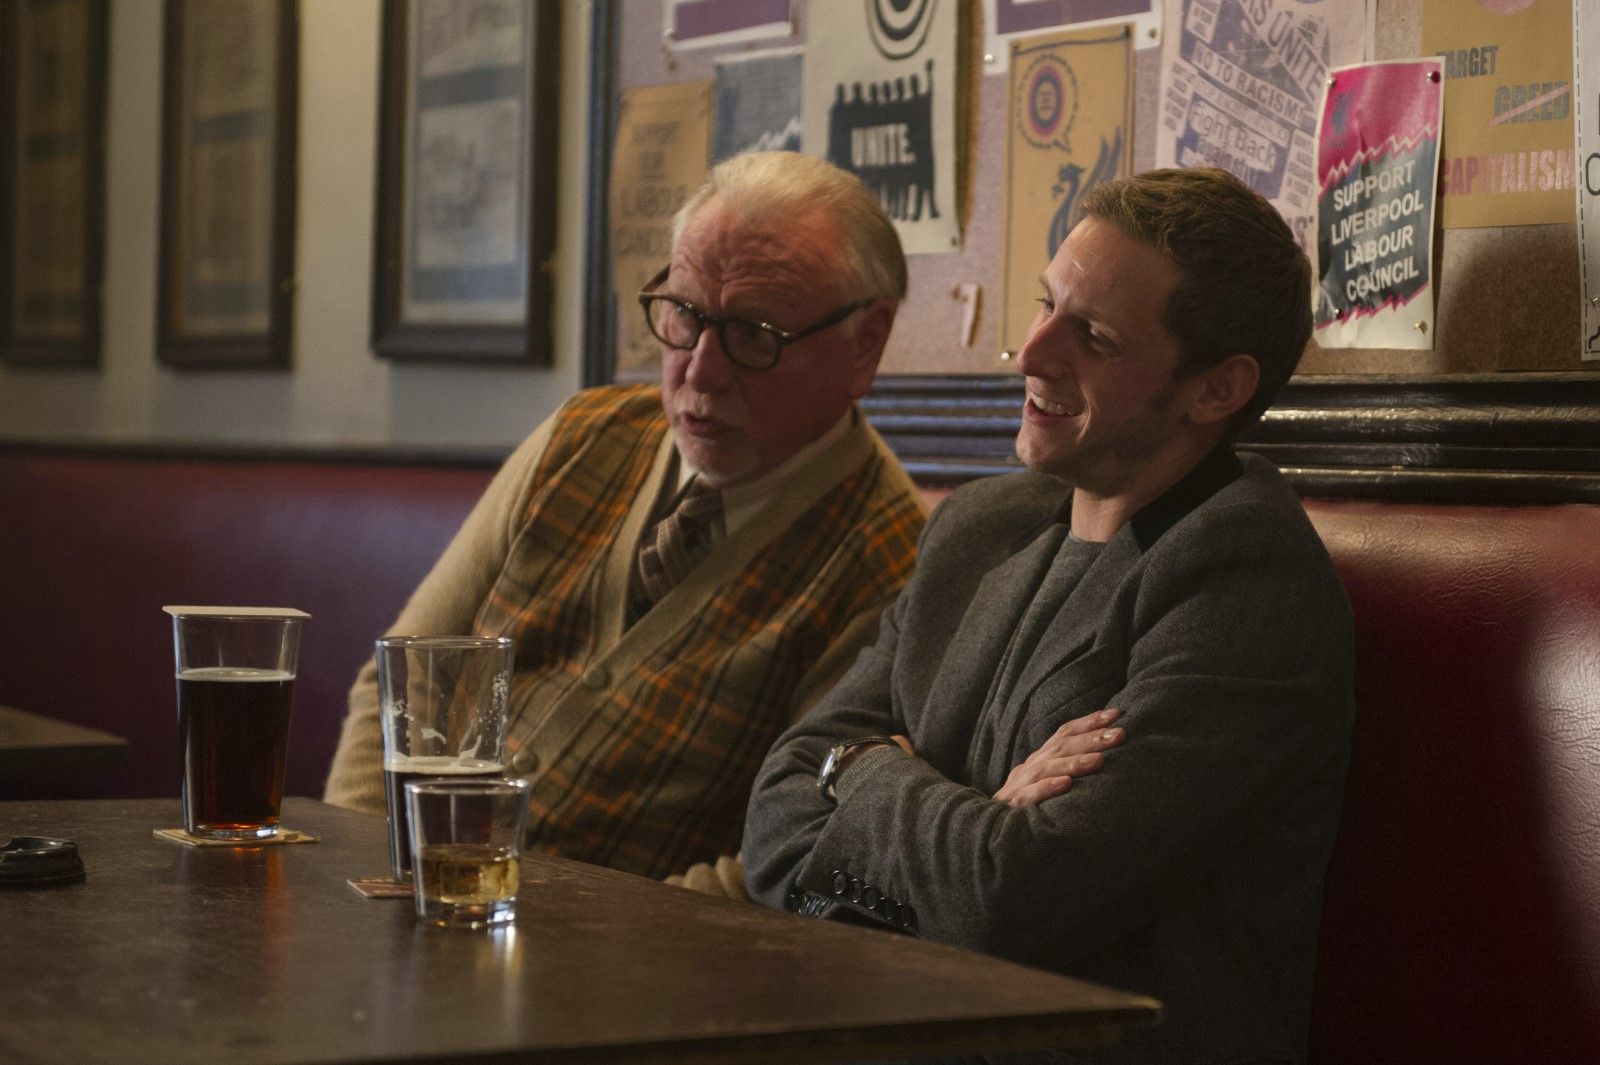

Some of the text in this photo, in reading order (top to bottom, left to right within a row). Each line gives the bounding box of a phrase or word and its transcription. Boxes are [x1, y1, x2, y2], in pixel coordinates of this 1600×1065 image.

[1216, 58, 1234, 83] TO
[1494, 80, 1571, 125] GREED
[851, 123, 917, 167] UNITE.
[1234, 126, 1275, 173] Back
[1333, 160, 1416, 212] SUPPORT
[1438, 148, 1576, 197] CAPITALISM
[1331, 189, 1425, 246] LIVERPOOL
[1344, 224, 1415, 272] LABOUR
[1346, 255, 1420, 302] COUNCIL
